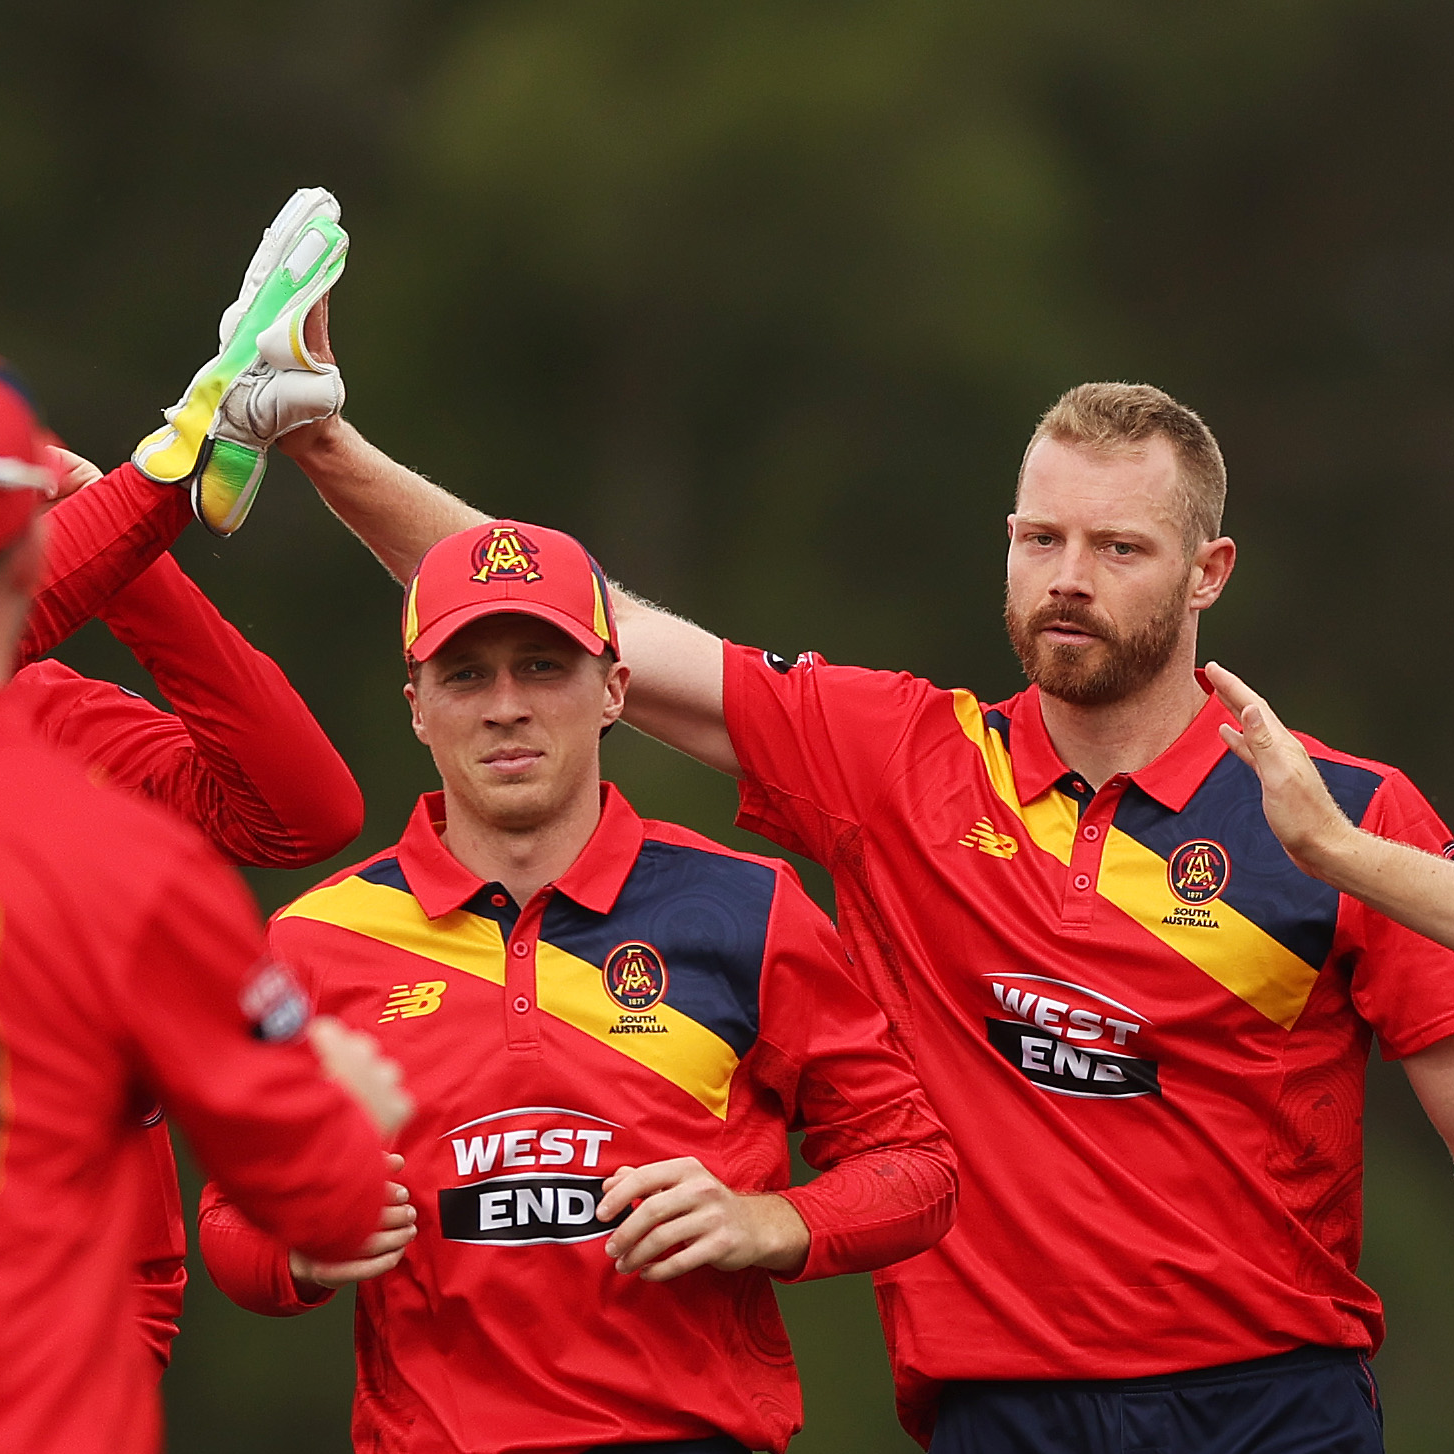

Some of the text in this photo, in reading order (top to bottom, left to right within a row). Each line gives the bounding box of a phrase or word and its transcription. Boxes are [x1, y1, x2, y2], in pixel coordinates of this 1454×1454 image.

[1173, 907, 1211, 918] SOUTH
[1161, 915, 1220, 929] AUSTRALIA
[619, 1015, 656, 1024] SOUTH
[992, 982, 1141, 1046] WEST
[609, 1025, 669, 1035] AUSTRALIA
[451, 1128, 613, 1177] WEST
[478, 1187, 596, 1232] END
